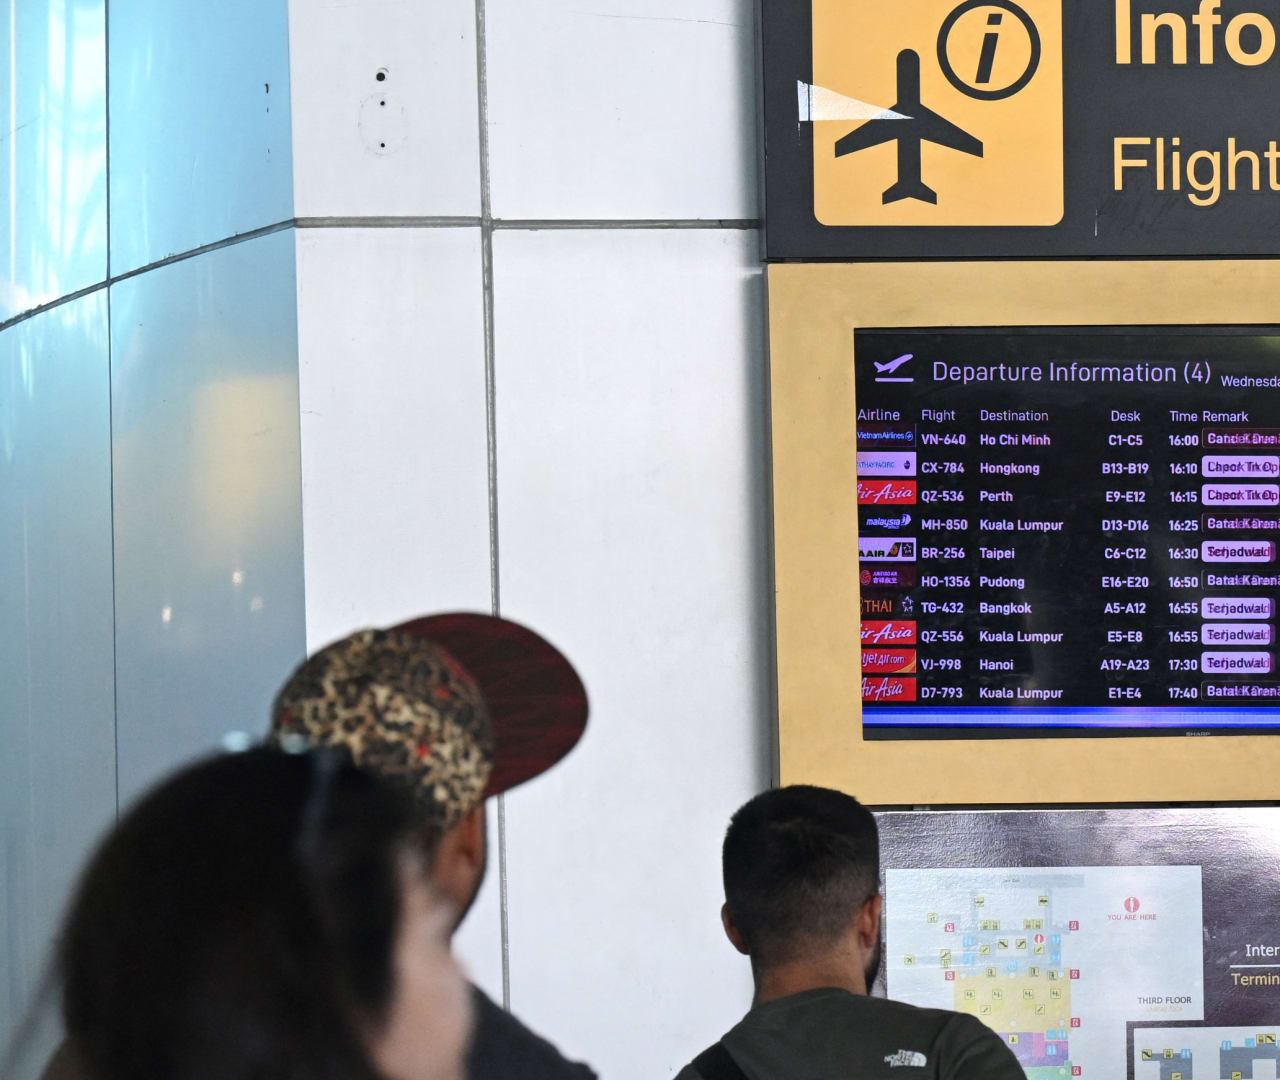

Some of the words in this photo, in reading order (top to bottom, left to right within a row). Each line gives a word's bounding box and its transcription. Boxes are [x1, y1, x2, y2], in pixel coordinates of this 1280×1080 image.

[934, 362, 1042, 384] Departure
[1050, 362, 1176, 381] Information
[1184, 362, 1210, 384] (4)
[858, 409, 900, 420] Airline
[922, 409, 955, 422] Flight
[981, 410, 1048, 421] Destination
[1111, 410, 1140, 421] Desk
[1170, 411, 1197, 421] Time
[1203, 411, 1248, 421] Remark
[922, 434, 966, 444] VN-640
[980, 434, 995, 445] Ho
[999, 434, 1018, 445] Chi
[1022, 435, 1050, 445] Minh
[1109, 435, 1142, 445] C1-C5
[1169, 435, 1198, 445] 16:00
[922, 462, 964, 473] CX-784
[980, 463, 1040, 475] Hongkong
[1102, 463, 1149, 474] B13-B19
[1170, 463, 1197, 474] 16:10
[922, 491, 964, 503] QZ-536
[980, 491, 1012, 501] Perth
[1106, 491, 1145, 502] E9-E12
[1170, 492, 1197, 502] 16:15
[922, 519, 967, 530] MH-850
[980, 520, 1014, 530] Kuala
[1018, 520, 1063, 532] Lumpur
[1102, 520, 1149, 530] D13-D16
[1169, 520, 1198, 531] 16:25
[922, 548, 965, 558] BR-256
[980, 547, 1014, 560] Taipei
[1105, 548, 1146, 559] C6-C12
[1168, 548, 1198, 559] 16:30
[922, 576, 970, 587] HO-1356
[980, 576, 1024, 589] Pudong
[1102, 577, 1149, 587] E16-E20
[1169, 577, 1198, 587] 16:50
[921, 602, 963, 613] TG-432
[980, 602, 1031, 615] Bangkok
[1104, 603, 1146, 613] A5-A12
[1169, 603, 1198, 613] 16:55
[1166, 996, 1192, 1004] FLOOR
